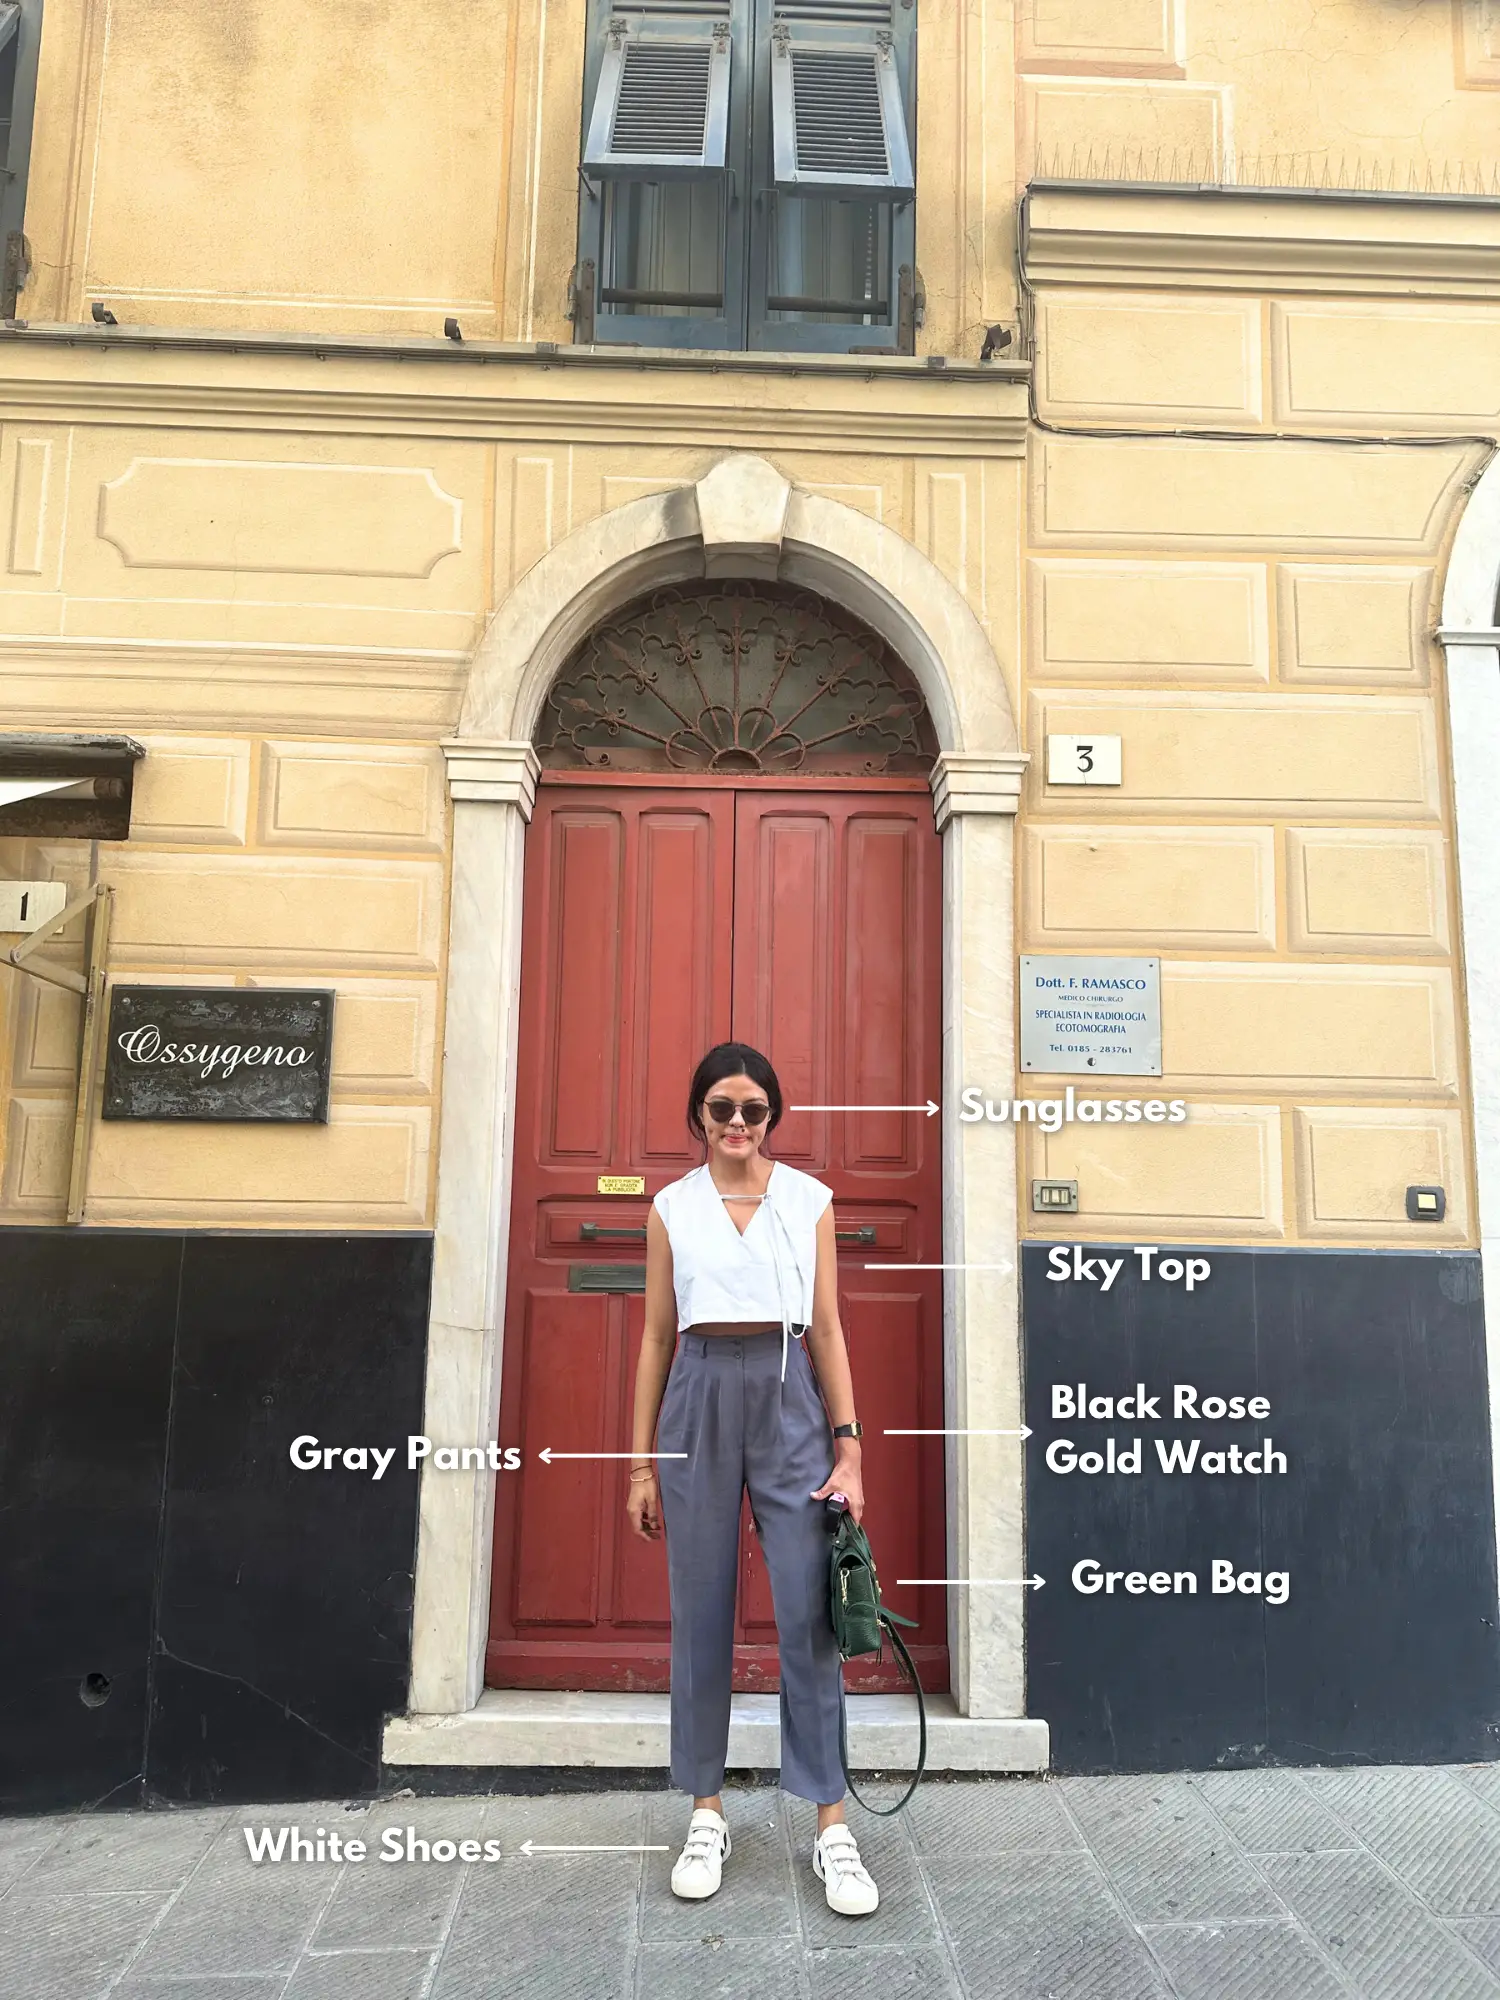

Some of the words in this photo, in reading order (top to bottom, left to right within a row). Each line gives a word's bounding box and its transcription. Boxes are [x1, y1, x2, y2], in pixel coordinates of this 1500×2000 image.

[1076, 745, 1094, 773] 3
[20, 891, 29, 921] 1
[1035, 977, 1065, 988] Dott.
[1069, 978, 1078, 988] F.
[1082, 978, 1146, 990] RAMASCO
[1035, 1009, 1082, 1020] SPECIALISTA
[1083, 1011, 1093, 1020] IN
[1094, 1011, 1147, 1021] RADIOLOGIA
[1055, 1023, 1127, 1034] ECOTOMOGRAFIA
[117, 1023, 314, 1079] Ossygeno
[1049, 1044, 1065, 1052] Tel.
[1067, 1045, 1090, 1053] 0185
[1099, 1046, 1133, 1054] 283761
